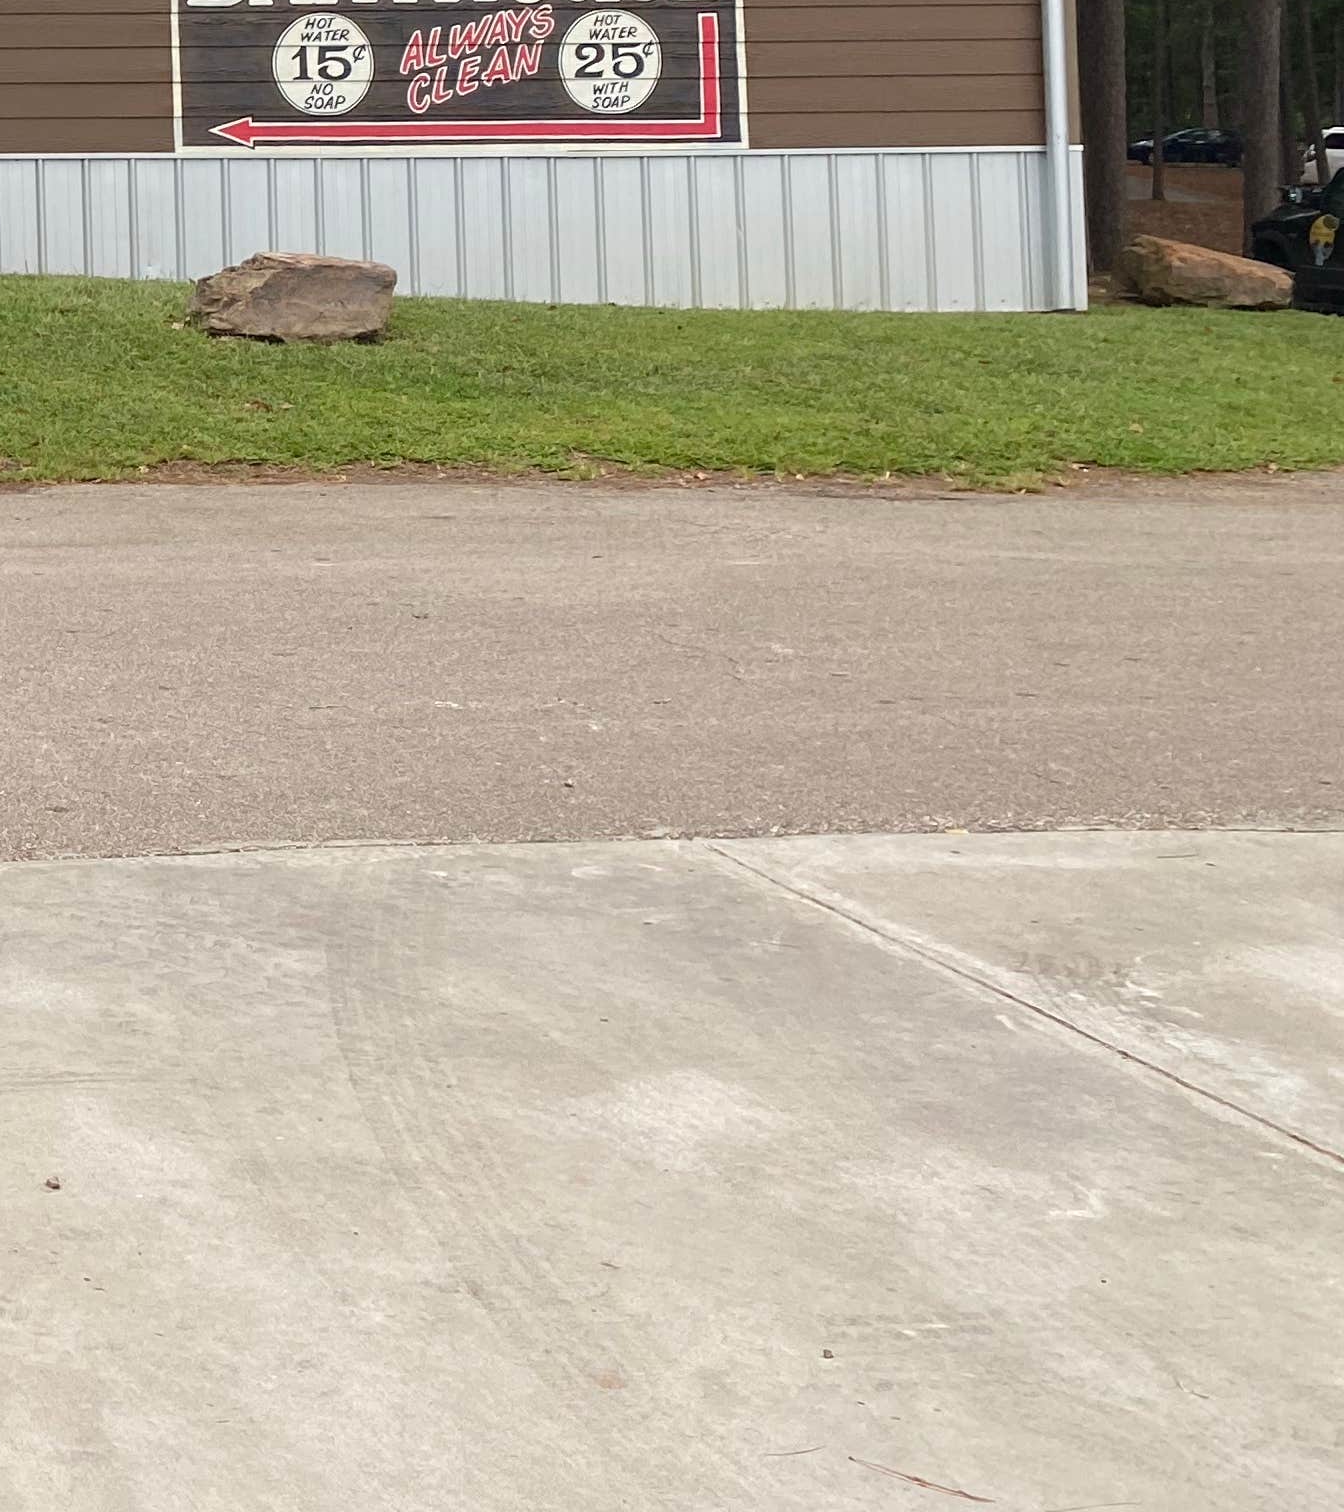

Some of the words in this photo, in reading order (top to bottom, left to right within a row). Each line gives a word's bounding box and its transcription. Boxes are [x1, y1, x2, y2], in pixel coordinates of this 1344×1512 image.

[304, 17, 336, 30] HOT
[593, 14, 621, 27] HOT
[300, 29, 350, 42] WATER
[399, 4, 556, 75] ALWAYS
[588, 27, 638, 41] WATER
[407, 39, 545, 114] CLEAN
[310, 82, 334, 95] NO
[592, 81, 629, 95] WITH
[303, 95, 347, 110] SOAP
[591, 95, 631, 109] SOAP
